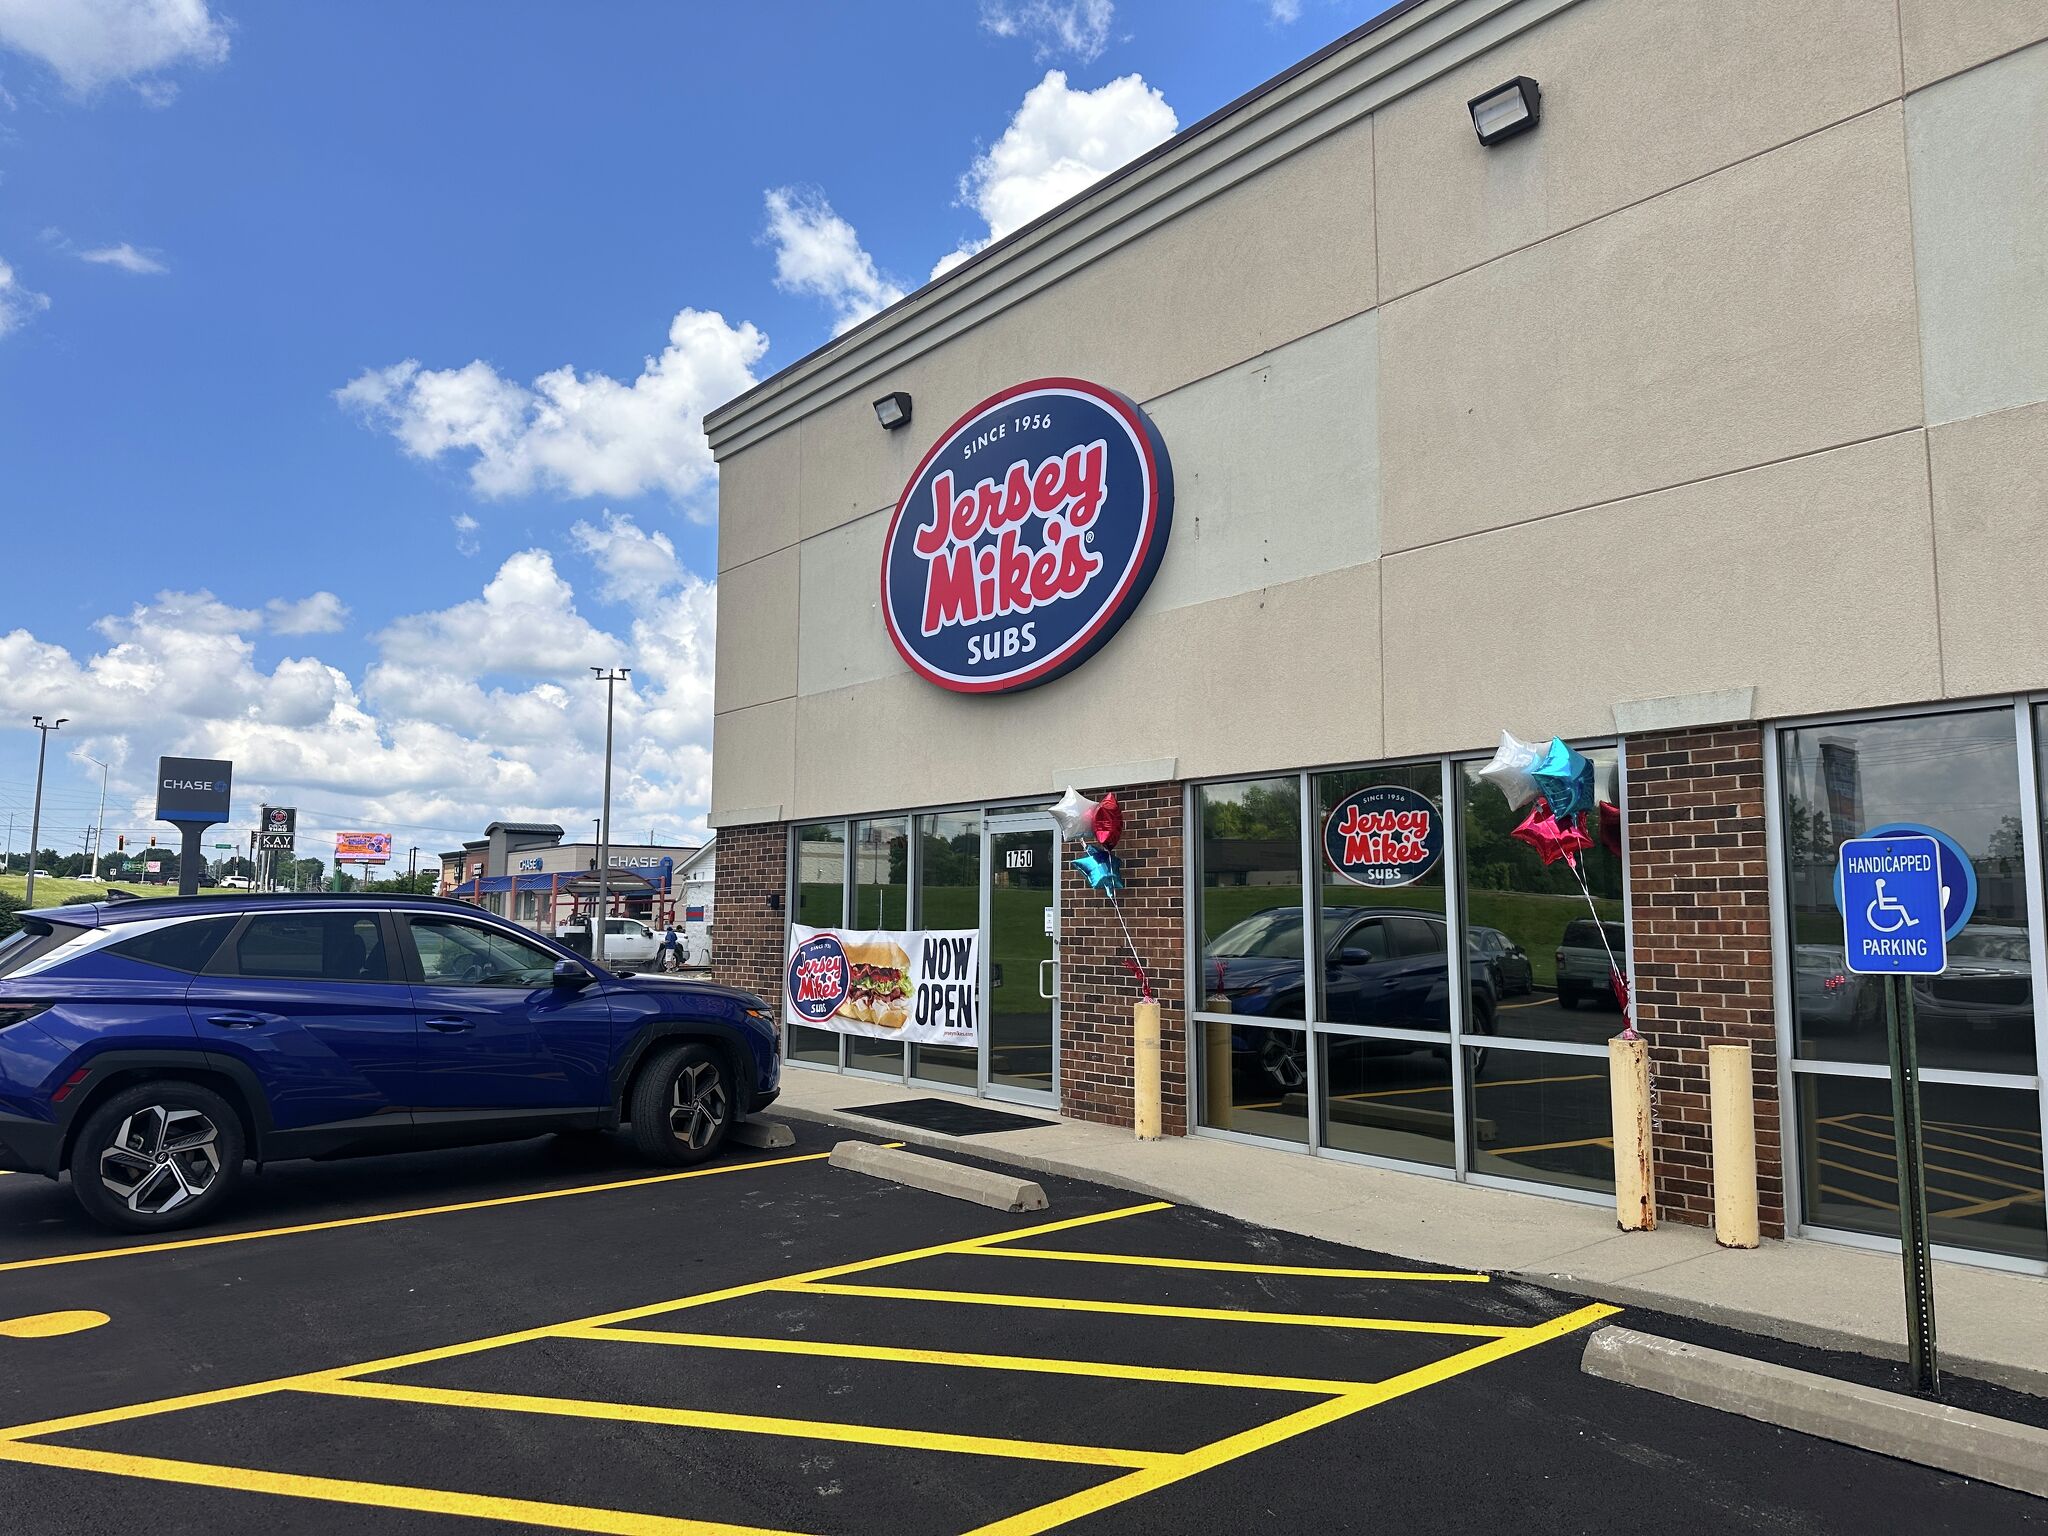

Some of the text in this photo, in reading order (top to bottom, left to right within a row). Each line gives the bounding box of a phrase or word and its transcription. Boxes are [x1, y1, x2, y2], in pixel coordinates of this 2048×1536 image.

[963, 413, 1052, 460] SINCE 1956
[913, 438, 1107, 555] Jersey
[921, 514, 1103, 637] Mike's
[967, 622, 1037, 664] SUBS
[163, 779, 213, 791] CHASE
[1362, 793, 1405, 804] SINCE 1956
[1338, 804, 1430, 841] Jersey
[263, 836, 291, 845] KAY
[1343, 832, 1429, 865] Mike's
[519, 858, 538, 871] CHASE
[608, 856, 659, 868] CHASE
[1007, 850, 1032, 867] 1750
[1848, 854, 1931, 874] HANDICAPPED
[1367, 868, 1401, 880] SUBS
[922, 937, 972, 981] NOW
[1862, 938, 1927, 957] PARKING
[797, 951, 842, 980] Jersey
[797, 974, 842, 1002] Mike's
[915, 983, 973, 1029] OPEN
